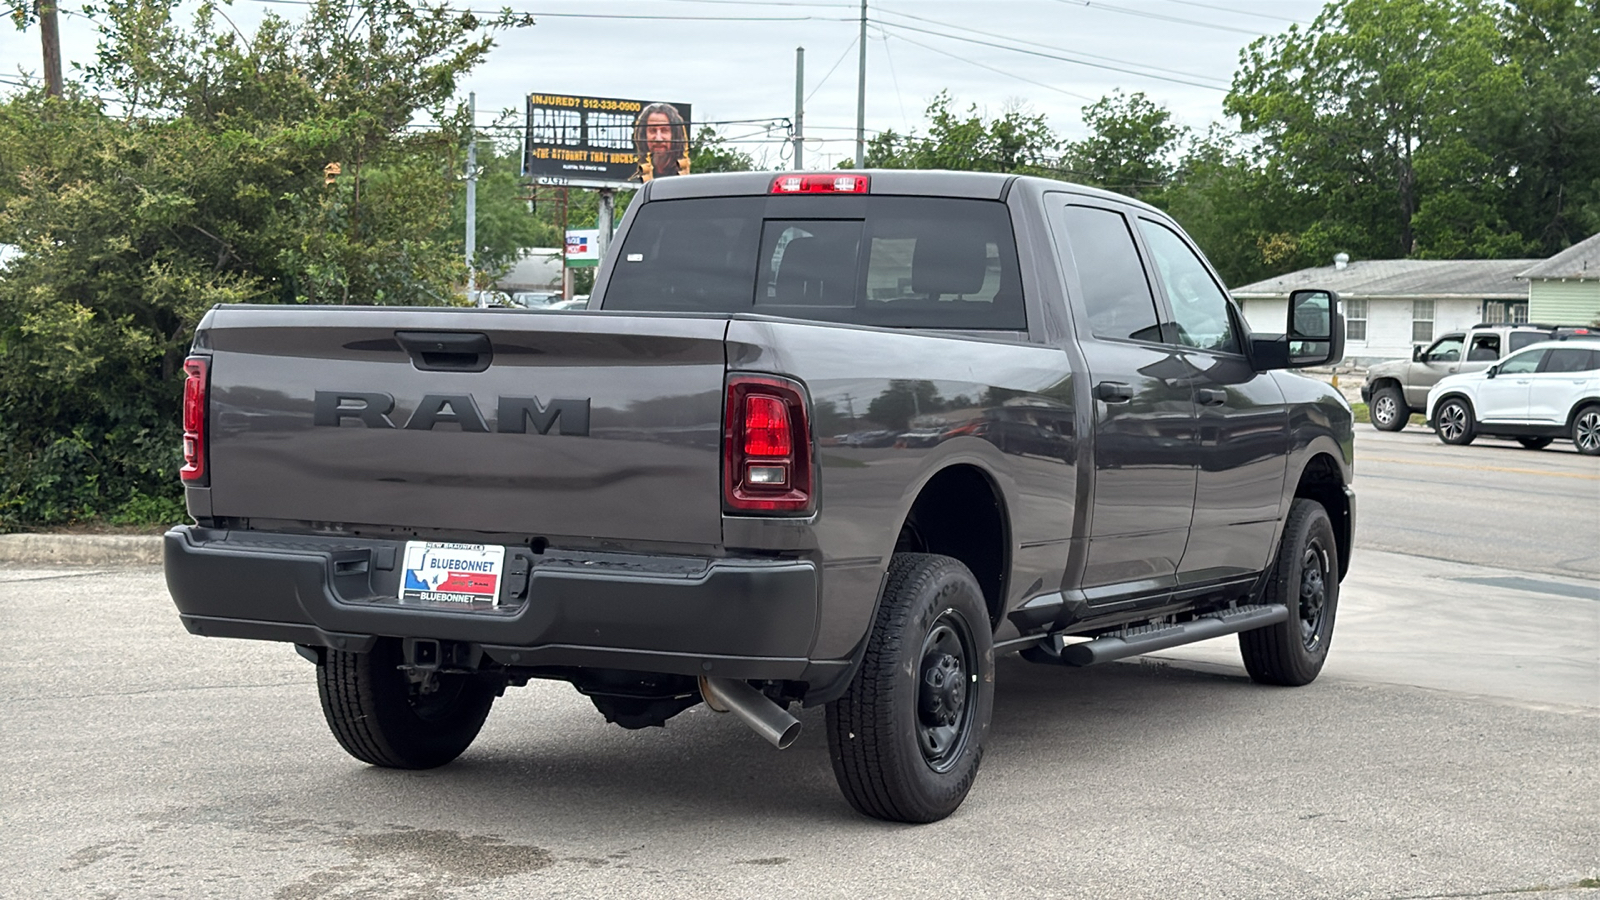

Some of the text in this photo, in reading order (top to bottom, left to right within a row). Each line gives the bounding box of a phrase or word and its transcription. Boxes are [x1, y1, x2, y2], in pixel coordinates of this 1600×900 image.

[532, 95, 641, 112] INJURED? 512-338-0900
[537, 148, 550, 159] THE
[551, 148, 588, 161] ATTORNEY
[590, 151, 608, 163] THAT
[314, 390, 591, 436] RAM
[430, 558, 494, 572] BLUEBONNET
[420, 592, 475, 603] BLUEBONNET
